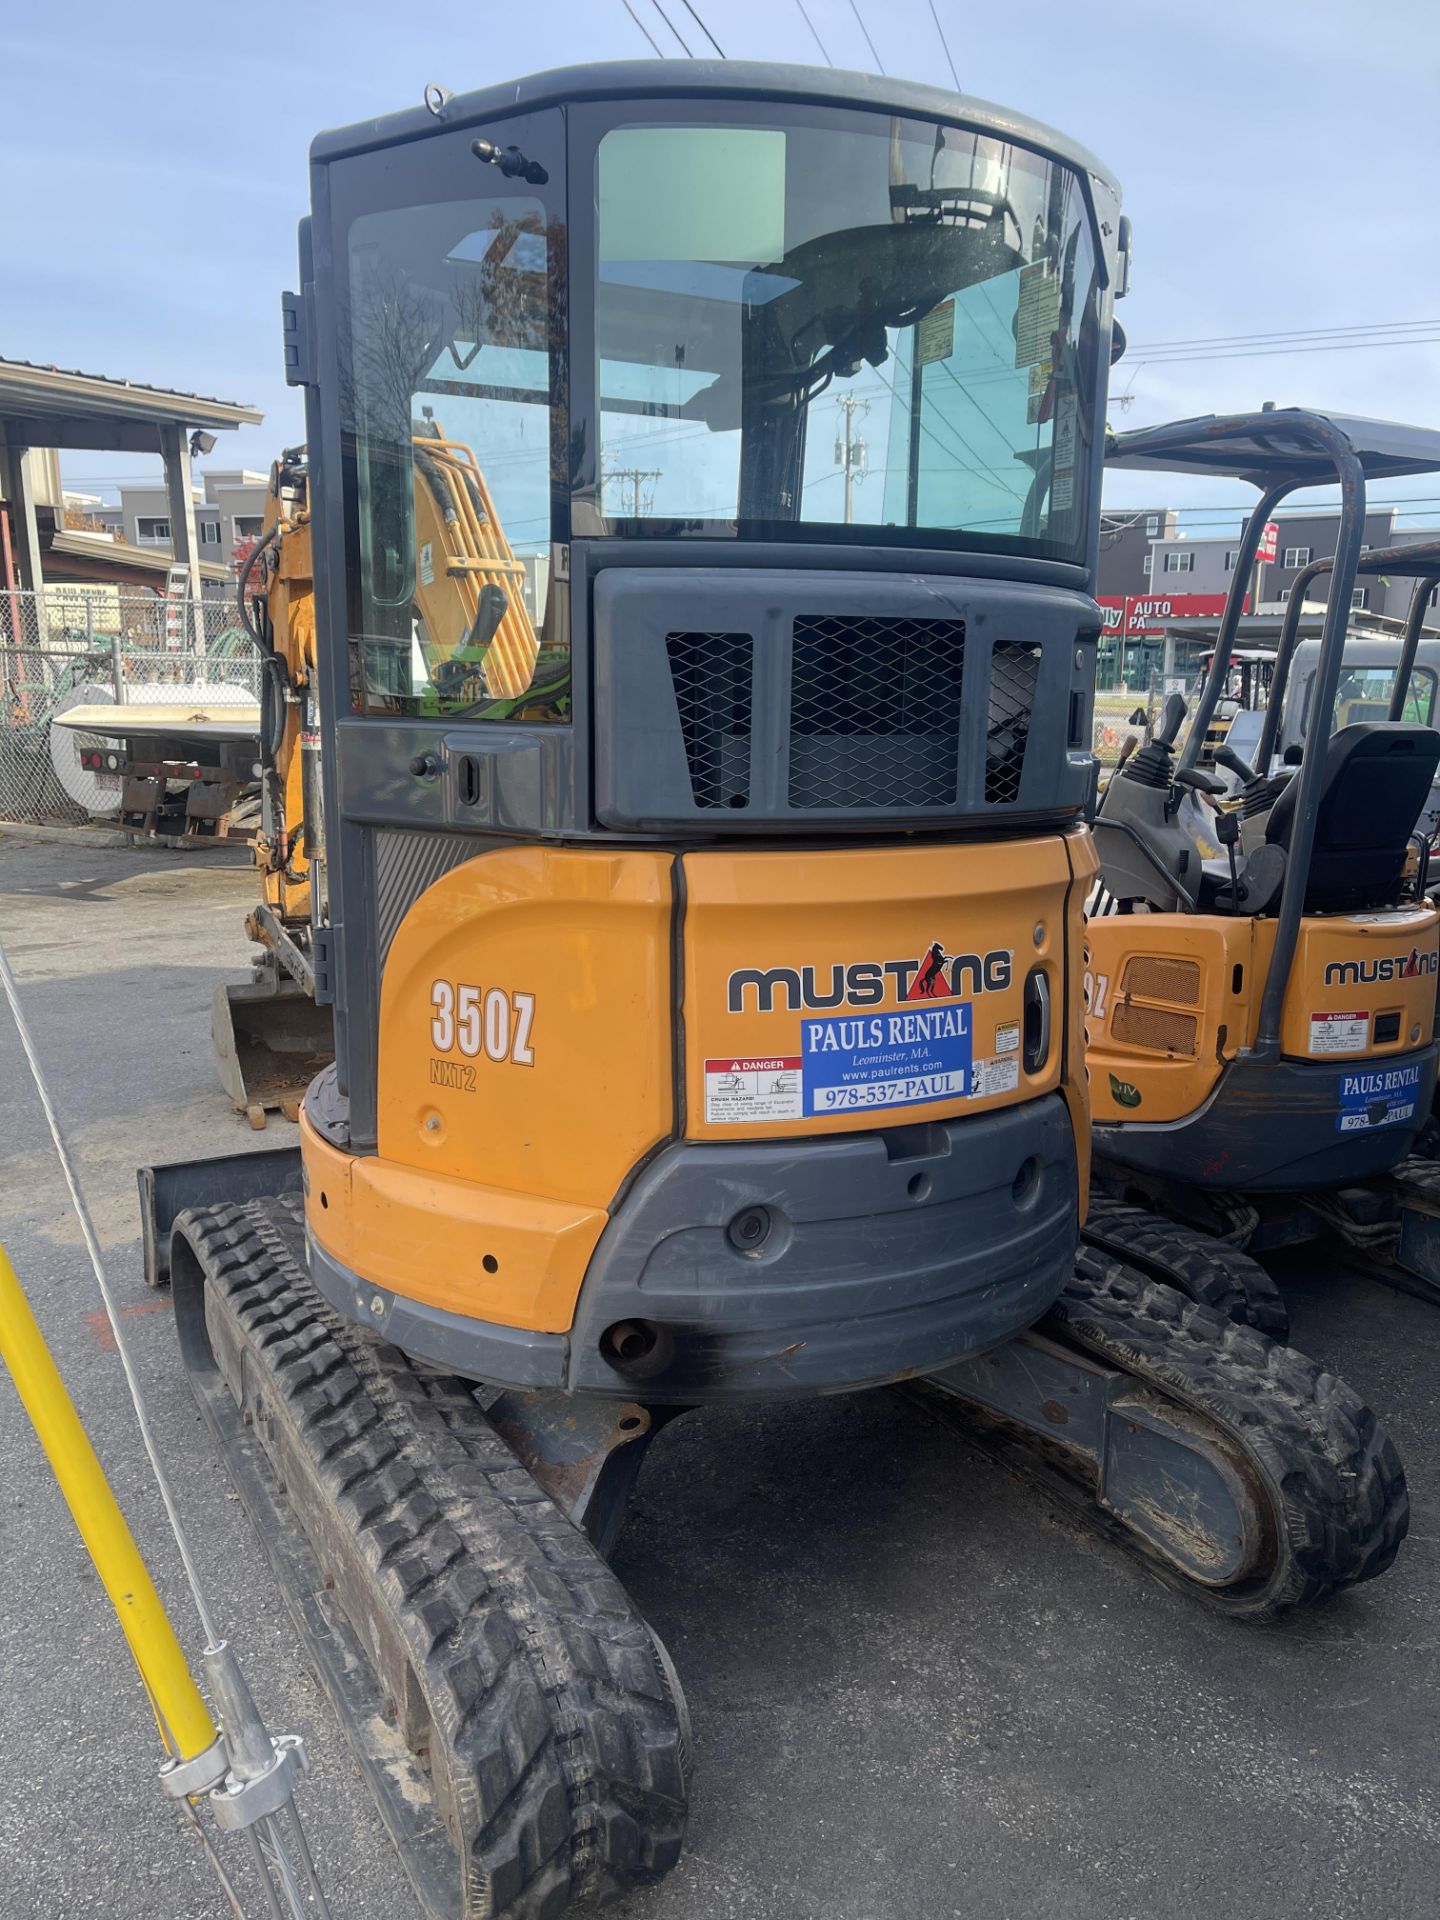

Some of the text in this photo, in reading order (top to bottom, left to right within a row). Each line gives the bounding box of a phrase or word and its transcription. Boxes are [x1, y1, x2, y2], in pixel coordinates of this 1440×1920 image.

[1134, 602, 1171, 615] AUTO
[728, 941, 1012, 1013] MUSTANG
[1324, 948, 1438, 986] MUSTANG
[430, 979, 536, 1067] 350Z
[808, 1019, 883, 1053] PAULS
[888, 1008, 968, 1046] RENTAL
[742, 1060, 784, 1070] DANGER
[842, 1060, 943, 1081] www.paulrents.com
[852, 1047, 932, 1066] Leominster, MA.
[430, 1059, 477, 1092] NXT2
[825, 1074, 956, 1108] 978-537-PAUL
[1343, 1066, 1419, 1096] PAULS RENTAL
[1347, 1106, 1410, 1128] 978--PAUL
